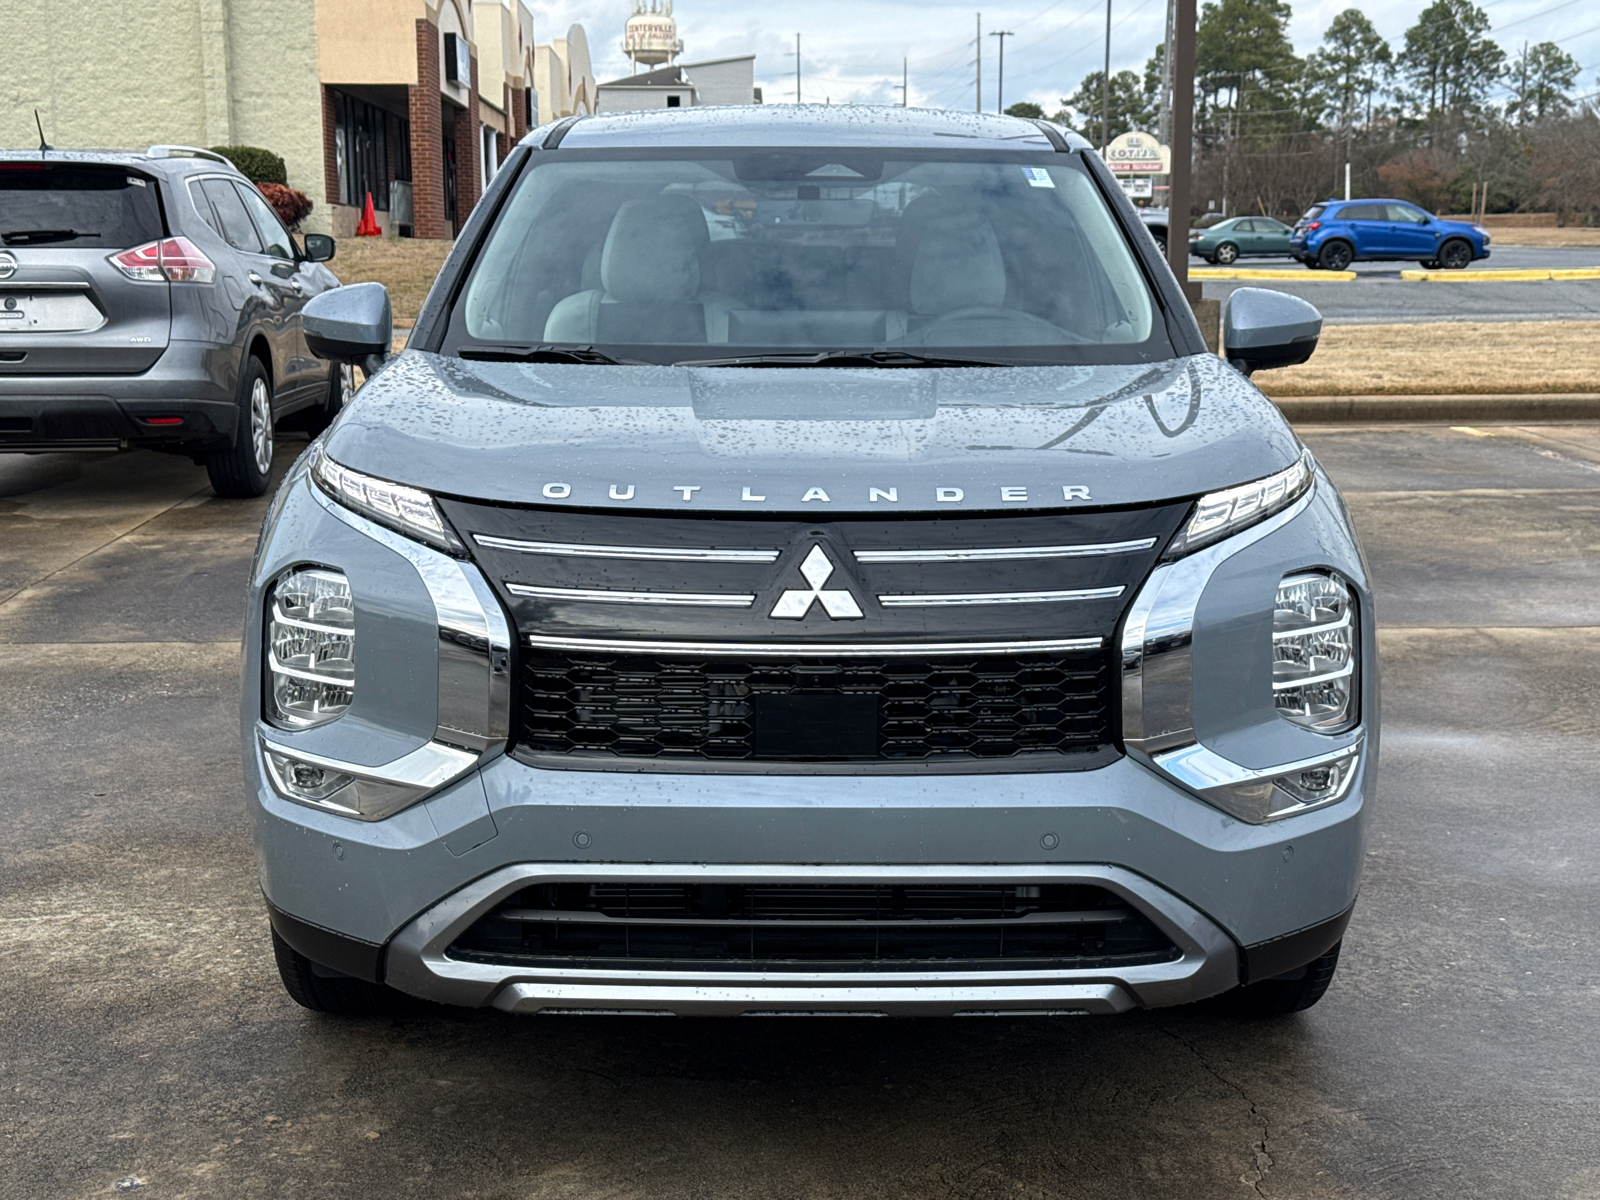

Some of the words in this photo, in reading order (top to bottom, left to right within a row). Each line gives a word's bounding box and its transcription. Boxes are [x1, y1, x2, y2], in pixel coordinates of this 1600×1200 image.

[628, 24, 672, 32] CENTERVILLE
[1110, 149, 1159, 158] COTIJA
[542, 482, 1093, 502] OUTLANDER
